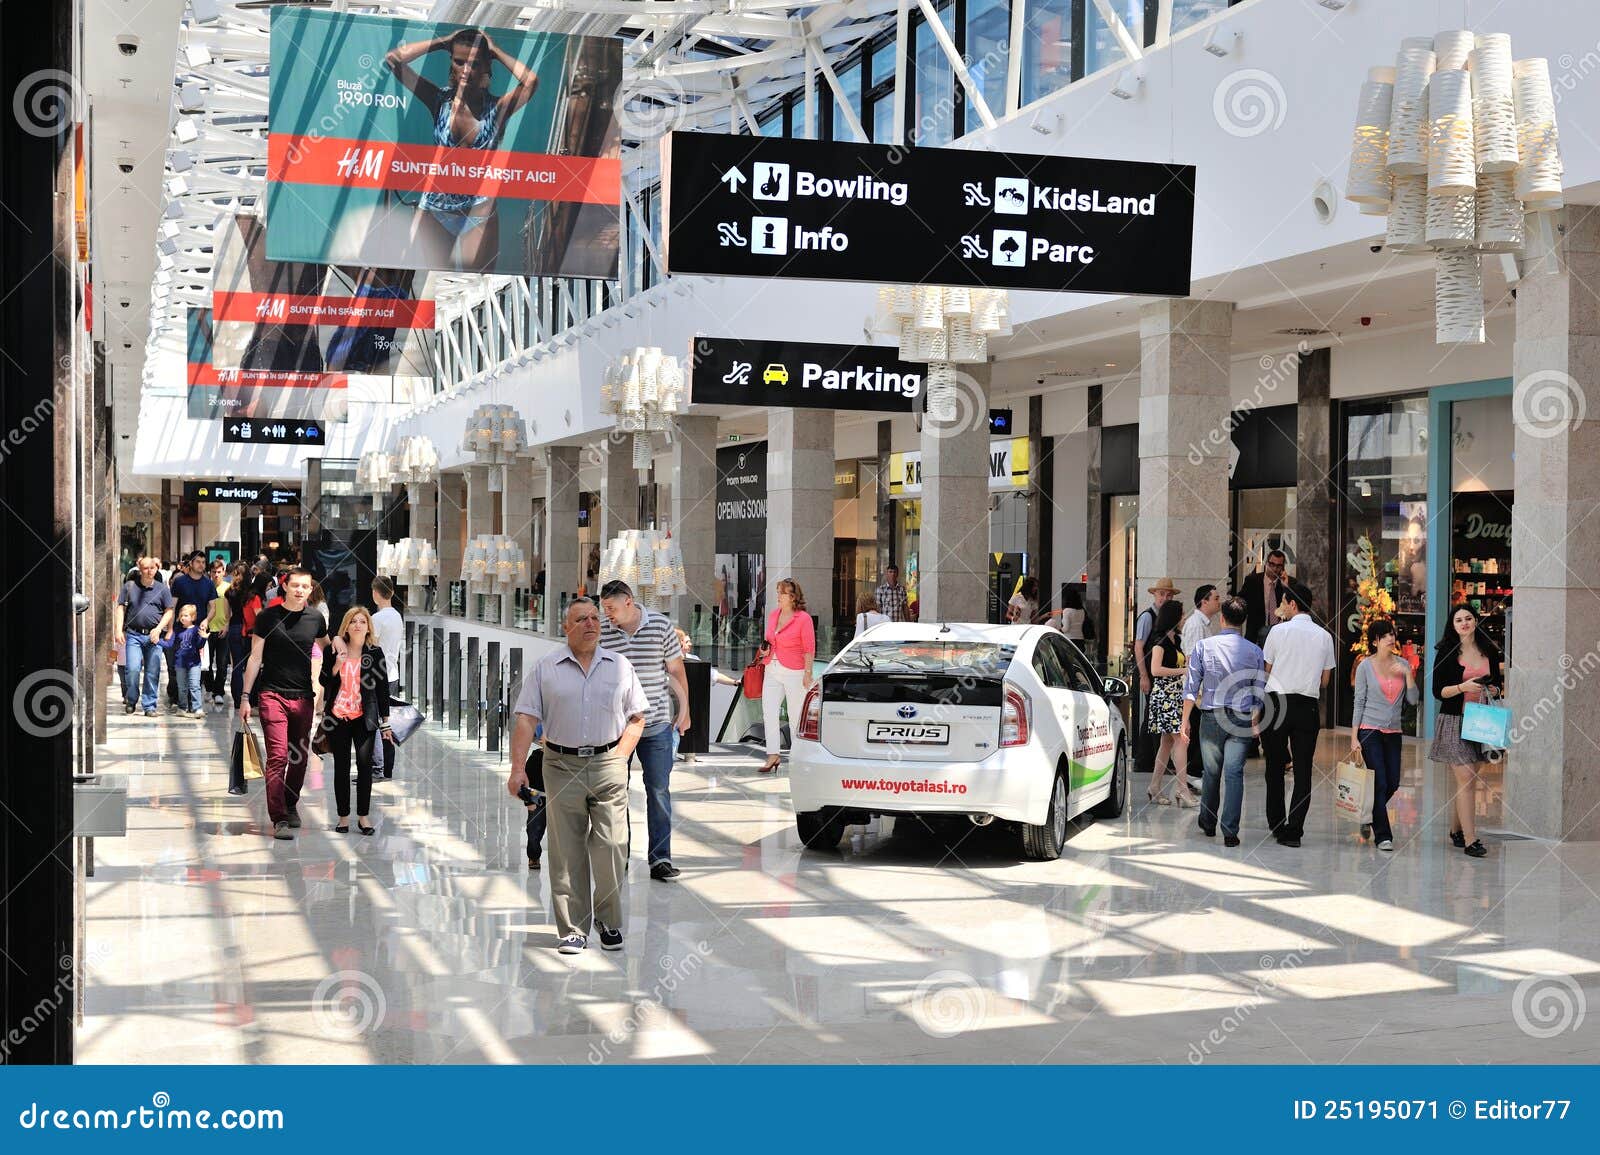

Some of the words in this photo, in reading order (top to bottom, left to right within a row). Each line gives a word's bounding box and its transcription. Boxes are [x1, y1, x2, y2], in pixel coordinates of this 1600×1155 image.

[337, 91, 373, 108] 19,90
[374, 93, 406, 110] RON
[337, 148, 385, 180] H&M
[391, 161, 449, 177] SUNTEM
[451, 163, 466, 178] ÎN
[525, 171, 556, 184] AICI!
[795, 171, 909, 206] Bowling
[1032, 185, 1155, 217] KidsLand
[793, 225, 849, 252] Info
[1031, 237, 1095, 265] Parc
[256, 298, 286, 319] H&M
[289, 305, 327, 316] SUNTEM
[802, 363, 922, 398] Parking
[989, 451, 1007, 478] NK
[215, 487, 258, 500] Parking
[717, 500, 746, 520] OPENING
[1464, 512, 1513, 548] Doug
[876, 727, 942, 739] PRIUS
[841, 778, 967, 795] www.toyotaiasi.ro
